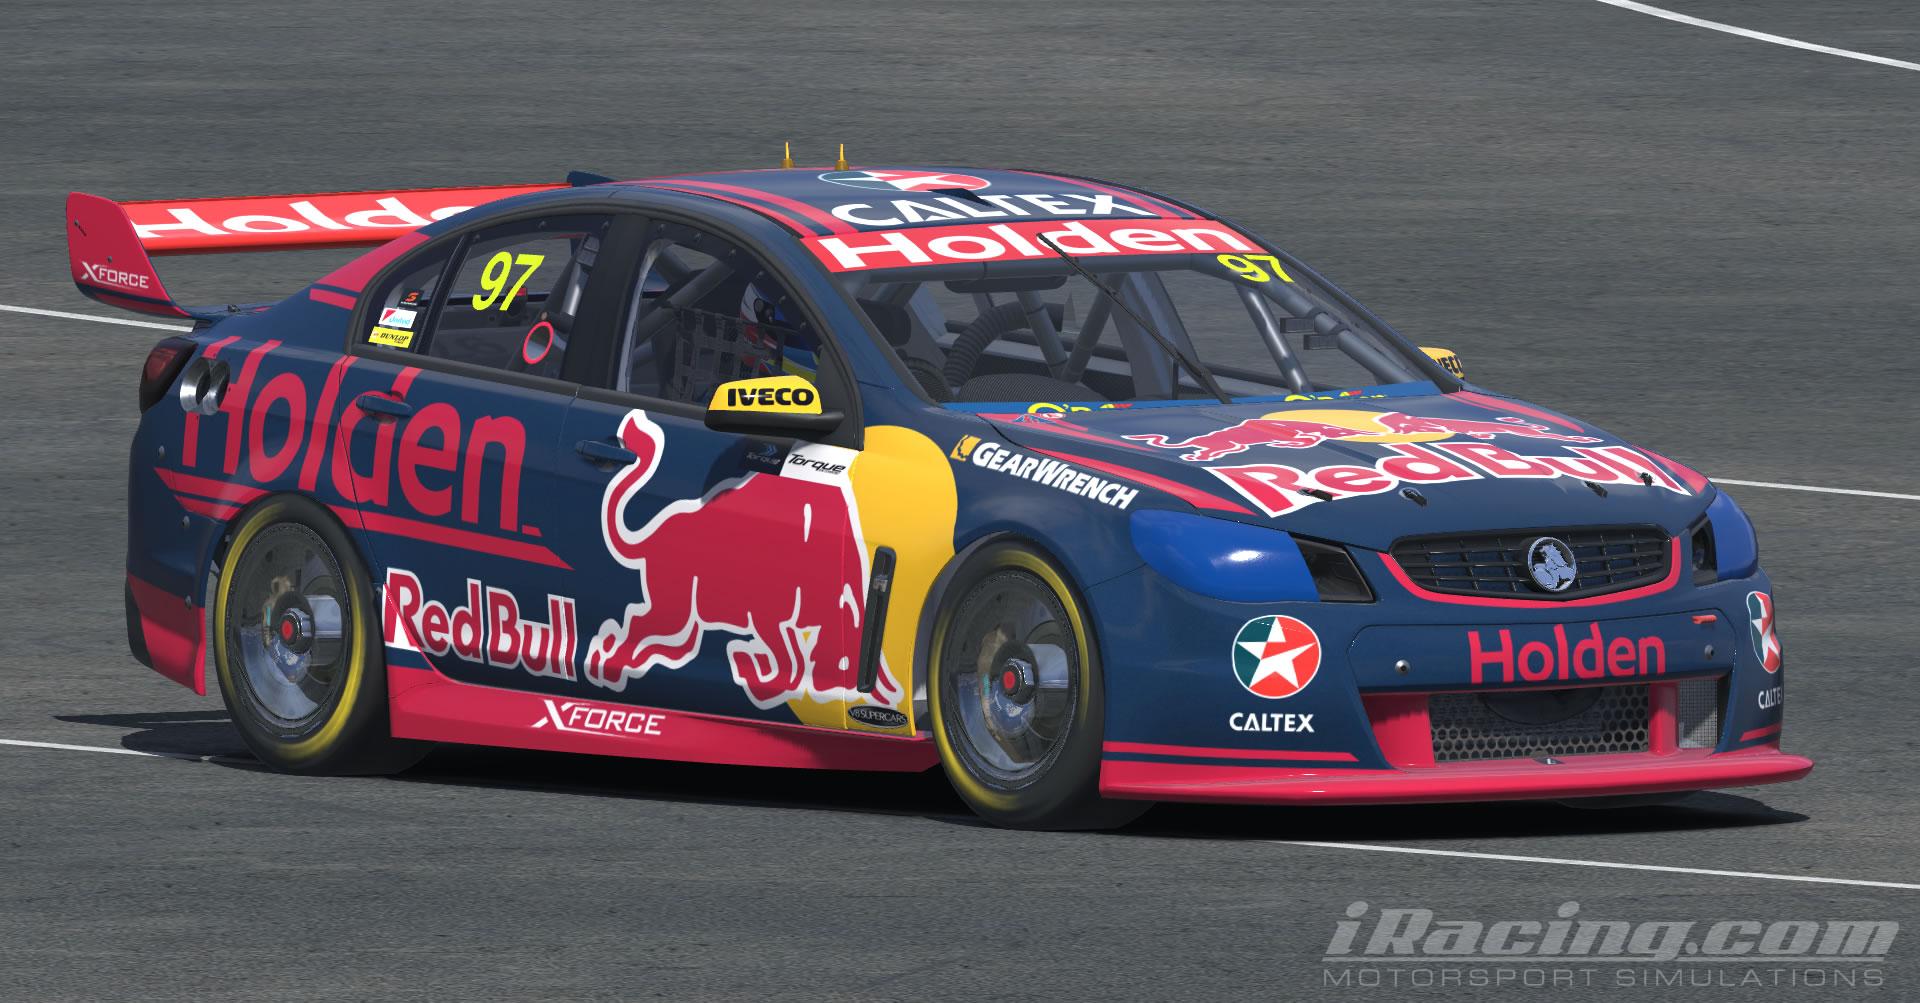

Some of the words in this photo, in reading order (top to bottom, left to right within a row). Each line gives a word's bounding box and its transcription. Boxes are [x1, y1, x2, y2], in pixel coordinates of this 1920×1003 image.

[129, 197, 477, 238] Hold
[831, 194, 1160, 227] CALTEX
[819, 220, 1254, 269] Holden
[81, 260, 149, 289] XFORCE
[472, 251, 545, 311] 97
[1216, 254, 1295, 283] 97
[380, 332, 409, 342] DUNLOP
[727, 387, 815, 407] IVECO
[181, 336, 527, 532] Holden
[787, 453, 847, 474] Torque
[1202, 442, 1484, 517] Red
[1442, 442, 1692, 497] Bull
[382, 568, 484, 664] Red
[486, 586, 577, 682] Bull
[1468, 621, 1667, 685] Holden
[1758, 686, 1783, 709] CALTE
[530, 699, 666, 736] XFORCE
[860, 708, 907, 724] SUPERCARS
[1229, 712, 1315, 733] CALTEX
